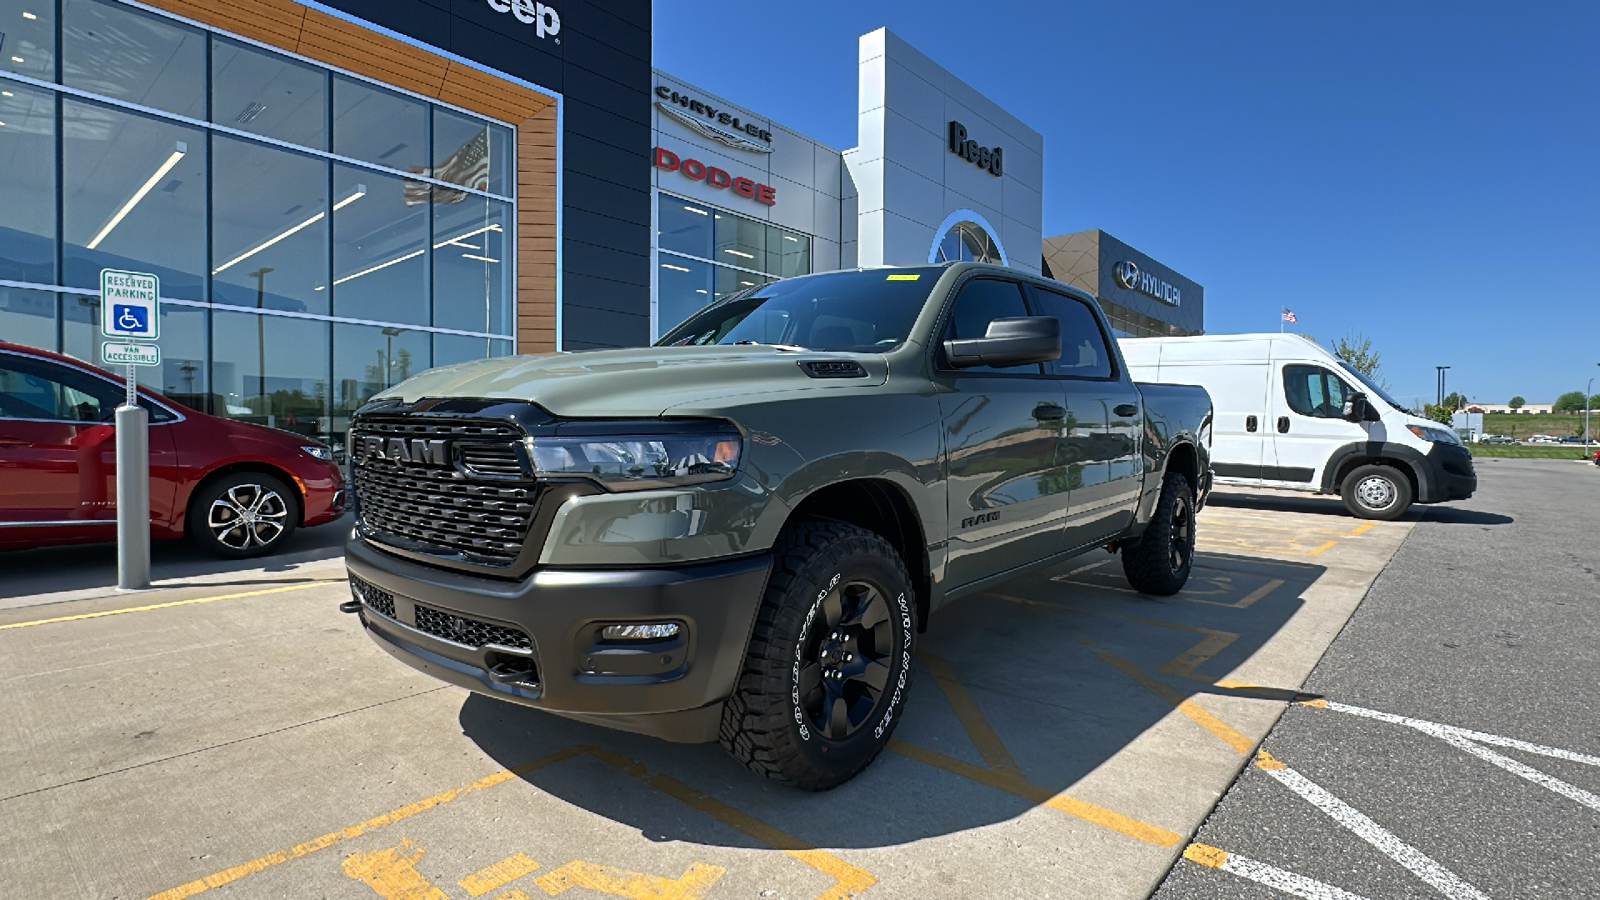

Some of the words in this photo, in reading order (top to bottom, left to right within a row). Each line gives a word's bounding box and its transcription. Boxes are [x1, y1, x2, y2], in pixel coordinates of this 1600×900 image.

[487, 0, 560, 39] eep
[655, 86, 772, 142] CHRYSLER
[949, 120, 1003, 177] Reed
[653, 147, 776, 206] DODGE
[107, 276, 153, 289] RESERVED
[107, 287, 154, 300] PARKING
[1141, 271, 1181, 307] HYUNDAI
[107, 353, 156, 362] ACCESSIBLE
[363, 436, 451, 466] RAM
[961, 511, 1001, 528] RAM
[792, 573, 841, 741] GOODYEAR
[875, 592, 911, 739] WRANGLER
